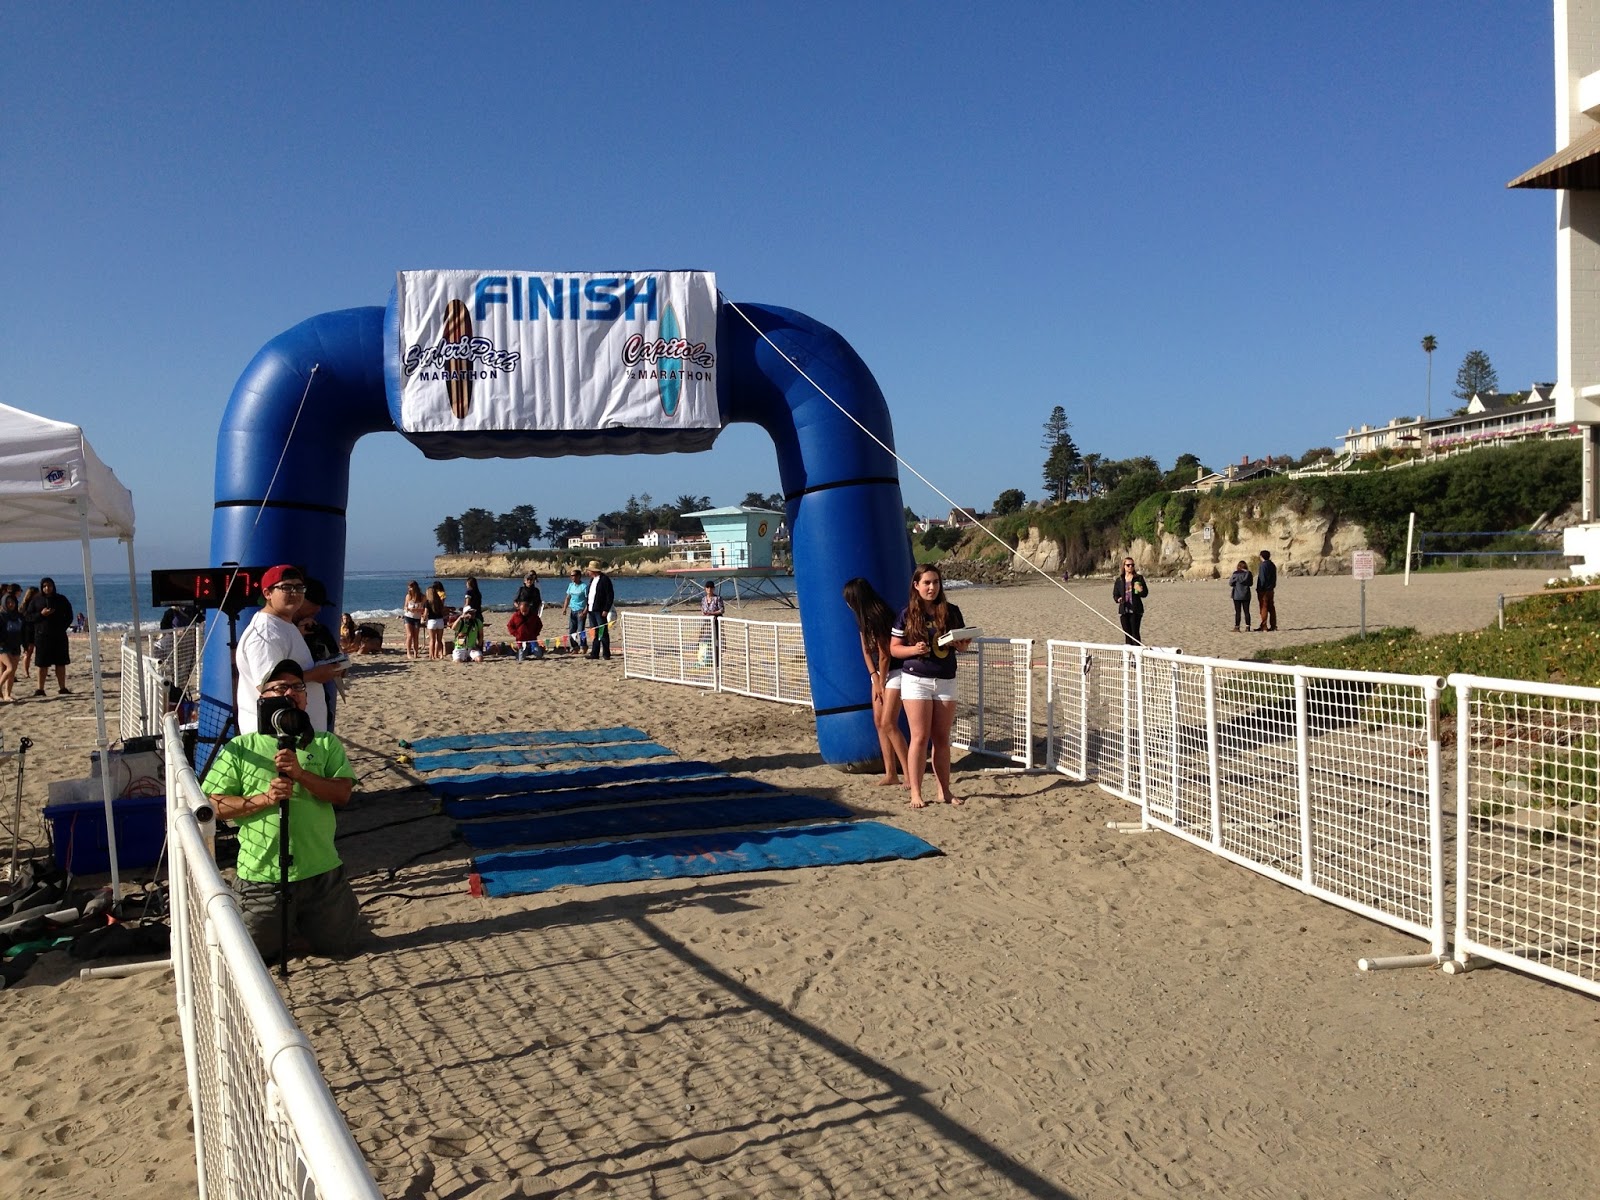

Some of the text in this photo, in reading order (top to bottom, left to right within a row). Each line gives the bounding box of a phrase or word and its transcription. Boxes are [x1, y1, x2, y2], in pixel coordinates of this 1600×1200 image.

[475, 276, 657, 321] FINISH
[403, 337, 520, 376] Surfer's Path
[622, 333, 714, 368] Capitola
[420, 370, 498, 381] MARATHON
[639, 370, 712, 381] MARATHON
